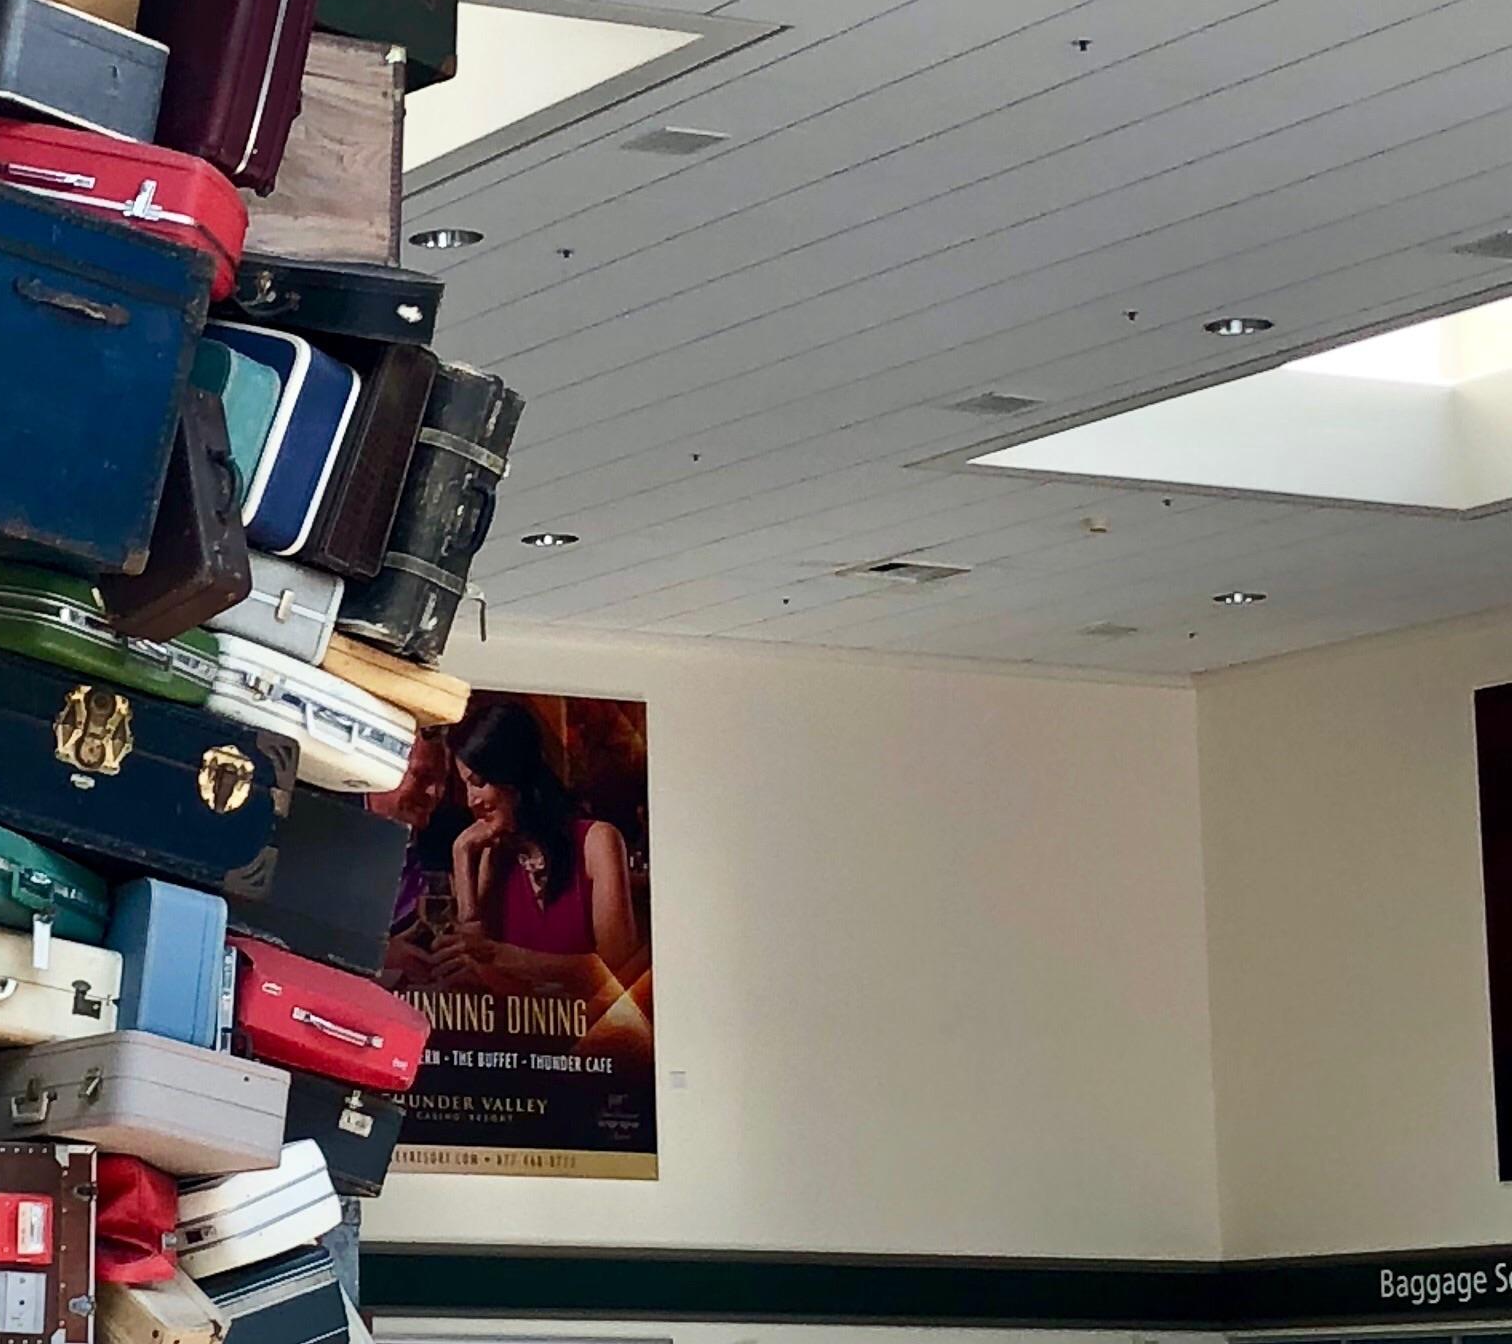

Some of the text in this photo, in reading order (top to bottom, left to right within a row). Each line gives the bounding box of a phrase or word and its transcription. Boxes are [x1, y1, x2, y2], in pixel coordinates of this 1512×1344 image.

[393, 990, 587, 1038] INNING DINING
[452, 1050, 474, 1067] THE
[477, 1051, 518, 1069] BUFFET
[530, 1053, 582, 1073] THUNDER
[586, 1056, 613, 1074] CAFE
[381, 1093, 548, 1115] HUNDER VALLEY
[1380, 1268, 1487, 1305] Baggage
